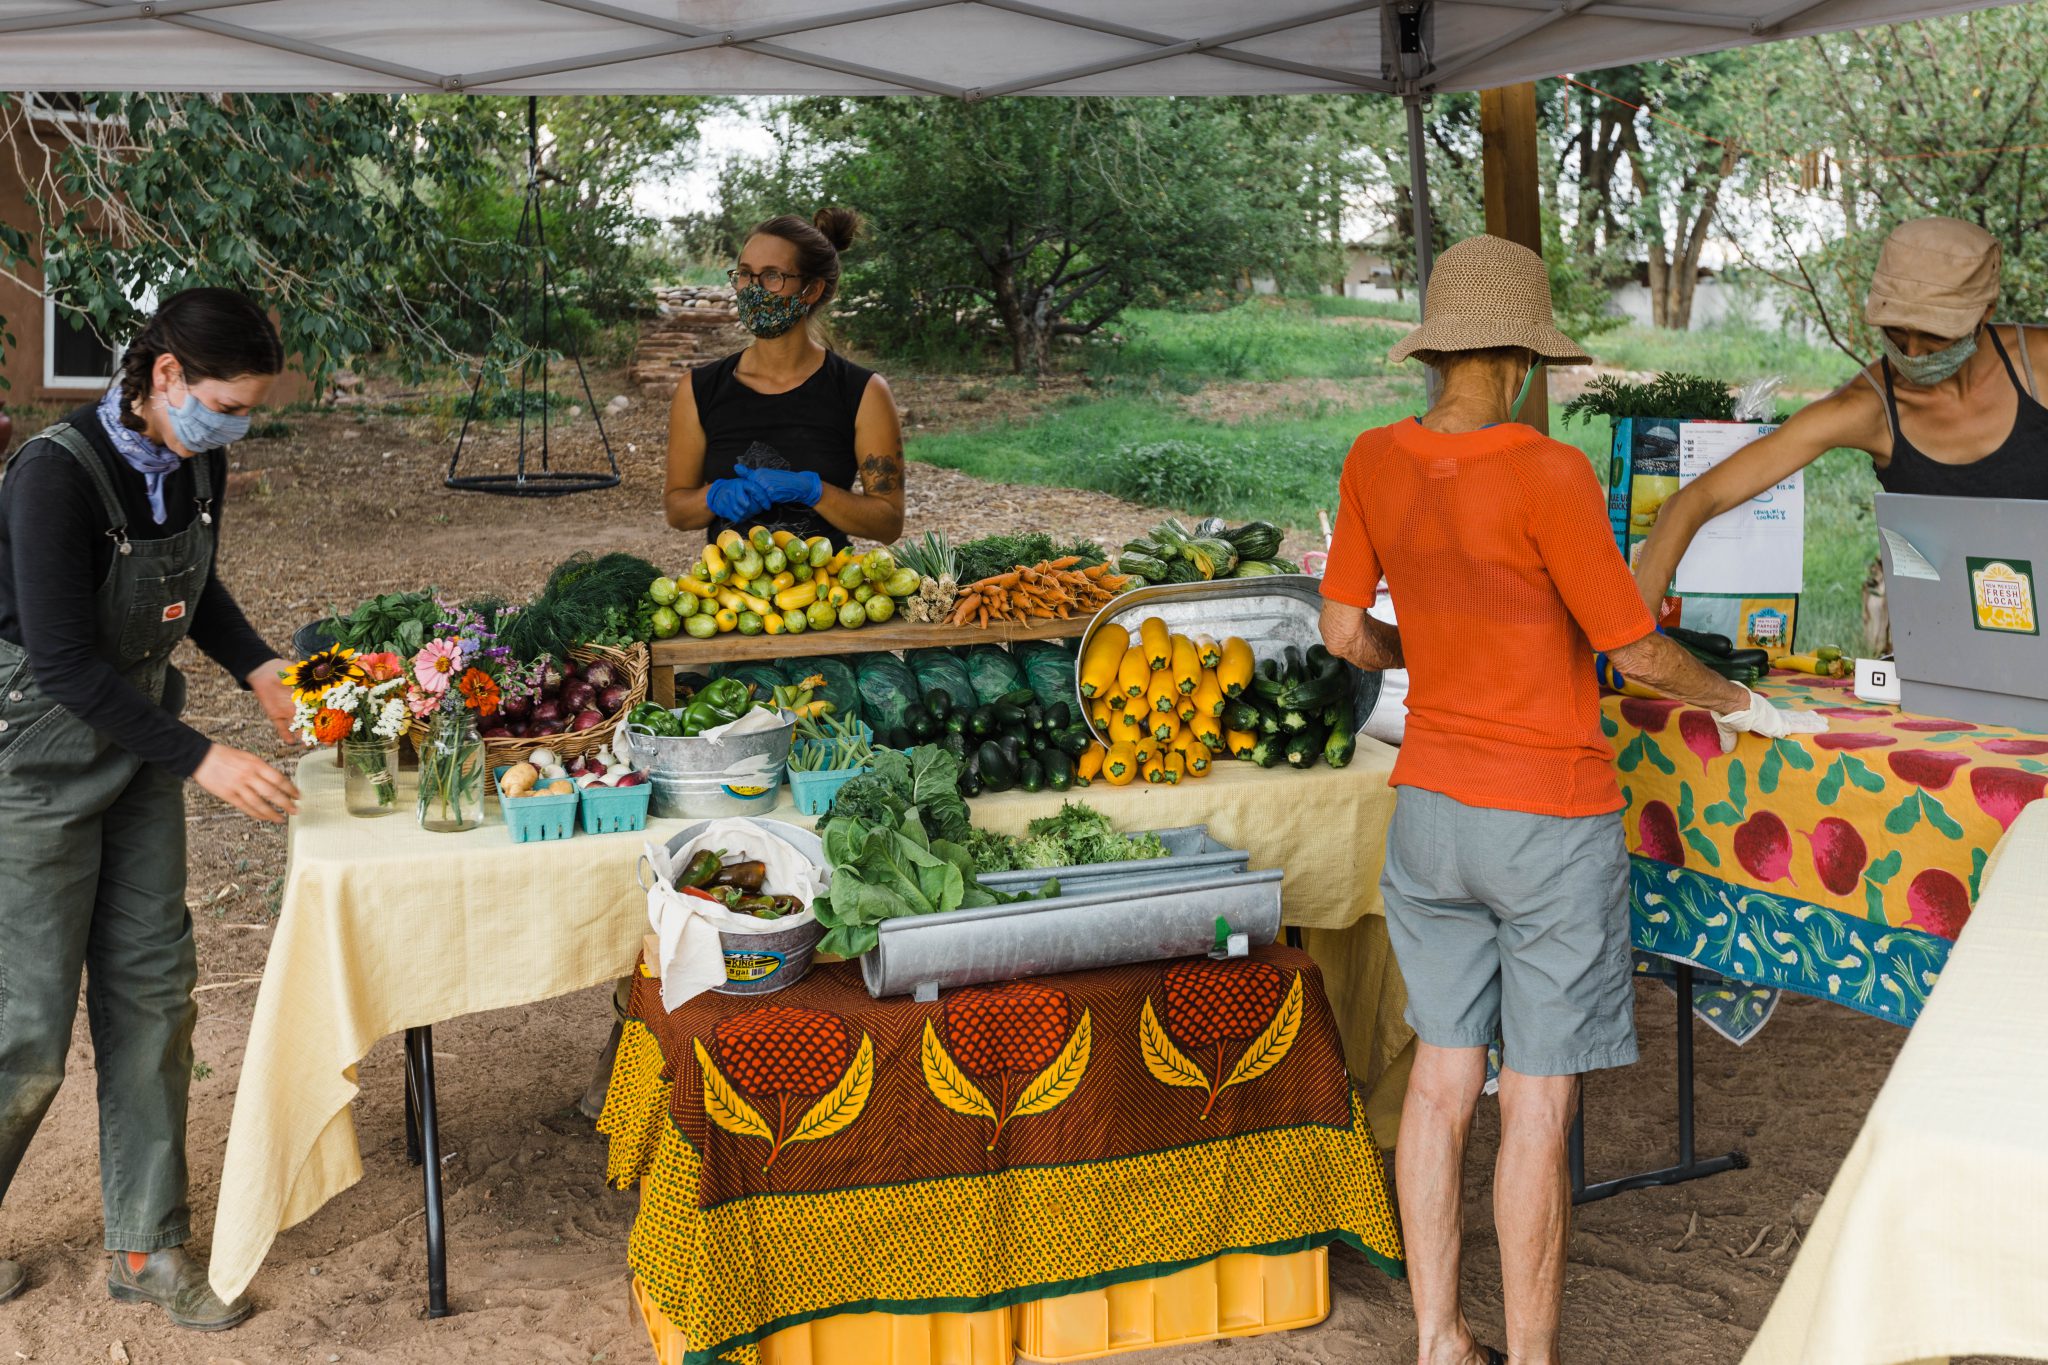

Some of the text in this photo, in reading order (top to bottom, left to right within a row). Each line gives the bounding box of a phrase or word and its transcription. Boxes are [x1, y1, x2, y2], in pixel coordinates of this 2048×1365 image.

[1987, 589, 2018, 597] FRESH
[1988, 597, 2019, 606] LOCAL
[731, 960, 755, 968] KING
